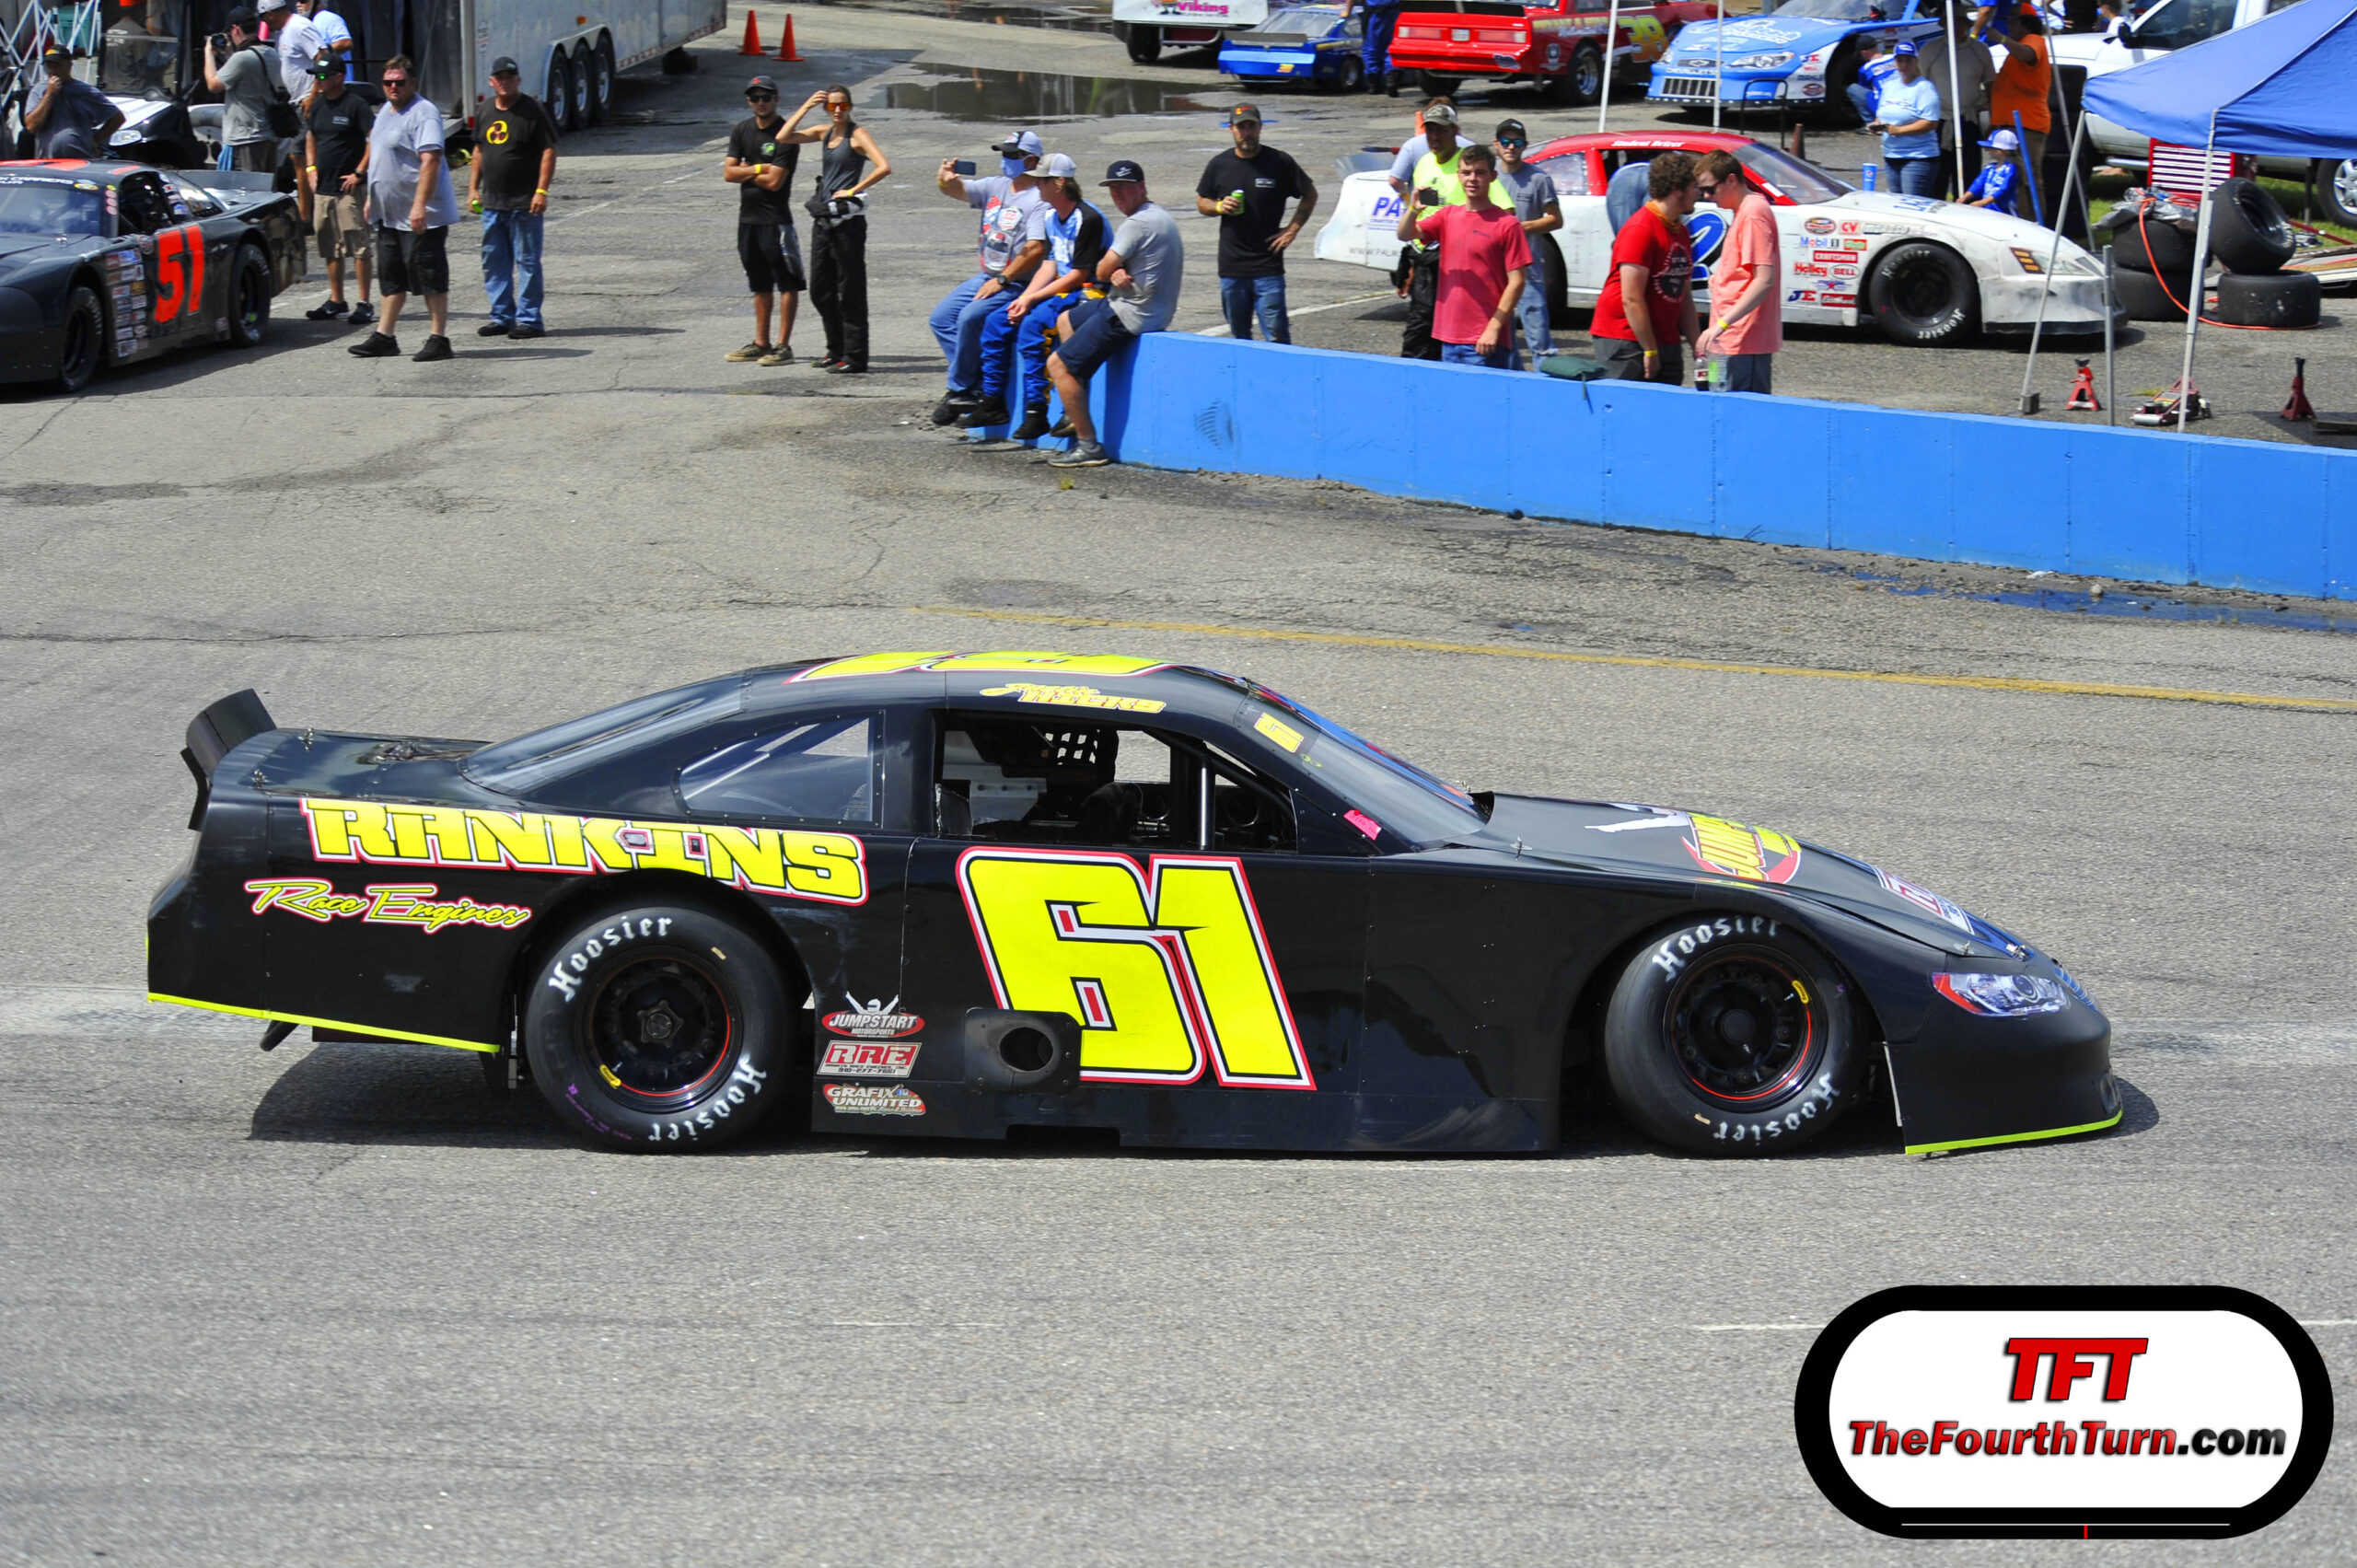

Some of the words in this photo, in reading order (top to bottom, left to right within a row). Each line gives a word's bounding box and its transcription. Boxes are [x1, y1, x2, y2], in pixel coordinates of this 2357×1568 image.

[1178, 1, 1229, 15] Viking
[1617, 15, 1669, 63] 38
[1372, 196, 1408, 217] PA
[1800, 236, 1828, 248] Mobil
[1794, 262, 1828, 277] Holley
[1833, 267, 1857, 276] BELL
[1787, 290, 1817, 302] JE
[299, 796, 870, 906] RANKINS
[245, 877, 367, 920] Race
[362, 883, 532, 935] Engines
[956, 846, 1317, 1091] 61
[829, 1014, 919, 1029] JUMPSTART
[825, 1043, 918, 1066] RRE
[827, 1086, 901, 1098] GRAFIX
[832, 1098, 922, 1108] UNLIMITED
